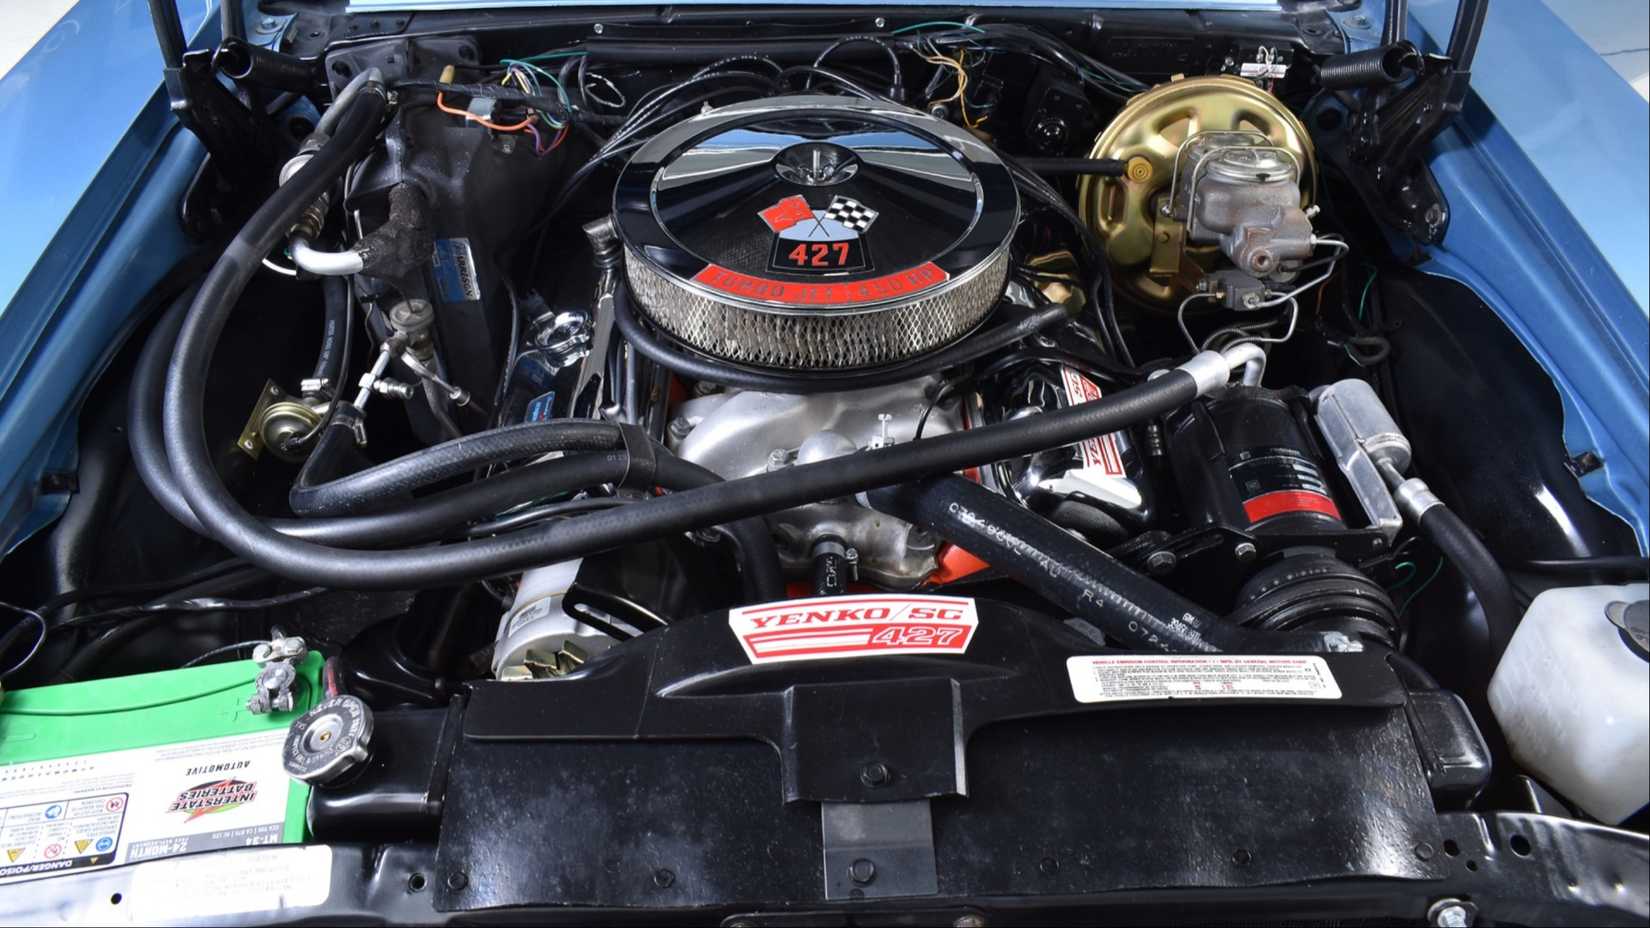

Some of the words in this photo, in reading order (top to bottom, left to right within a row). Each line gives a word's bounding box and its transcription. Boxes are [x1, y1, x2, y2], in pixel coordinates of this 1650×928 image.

[788, 242, 849, 266] 427
[872, 626, 964, 646] 427
[185, 760, 251, 777] AUTOMOTIVE
[170, 793, 255, 811] INTERSTATE
[179, 783, 255, 802] BATTERIES
[130, 841, 188, 860] 24-MONTH
